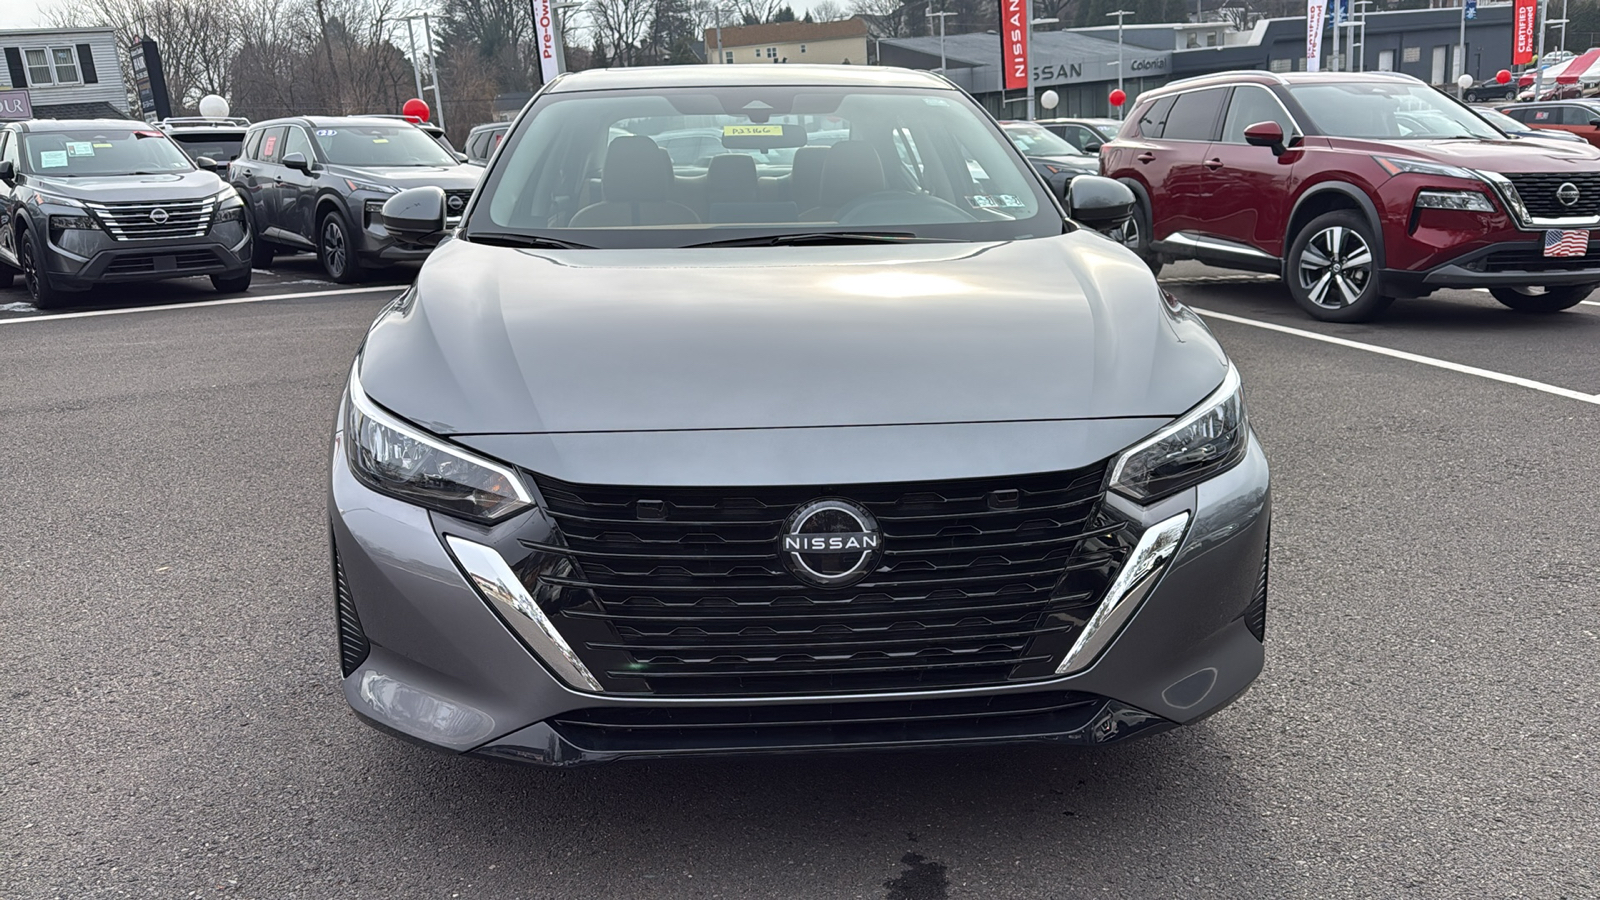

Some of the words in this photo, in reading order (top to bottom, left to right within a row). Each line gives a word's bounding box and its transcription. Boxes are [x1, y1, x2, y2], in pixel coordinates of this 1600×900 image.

[1009, 0, 1026, 78] NISSAN
[1518, 6, 1527, 53] CERTIFIED
[1526, 6, 1534, 52] Pre-Owned
[1131, 58, 1167, 71] Colonial
[785, 535, 877, 550] NISSAN
